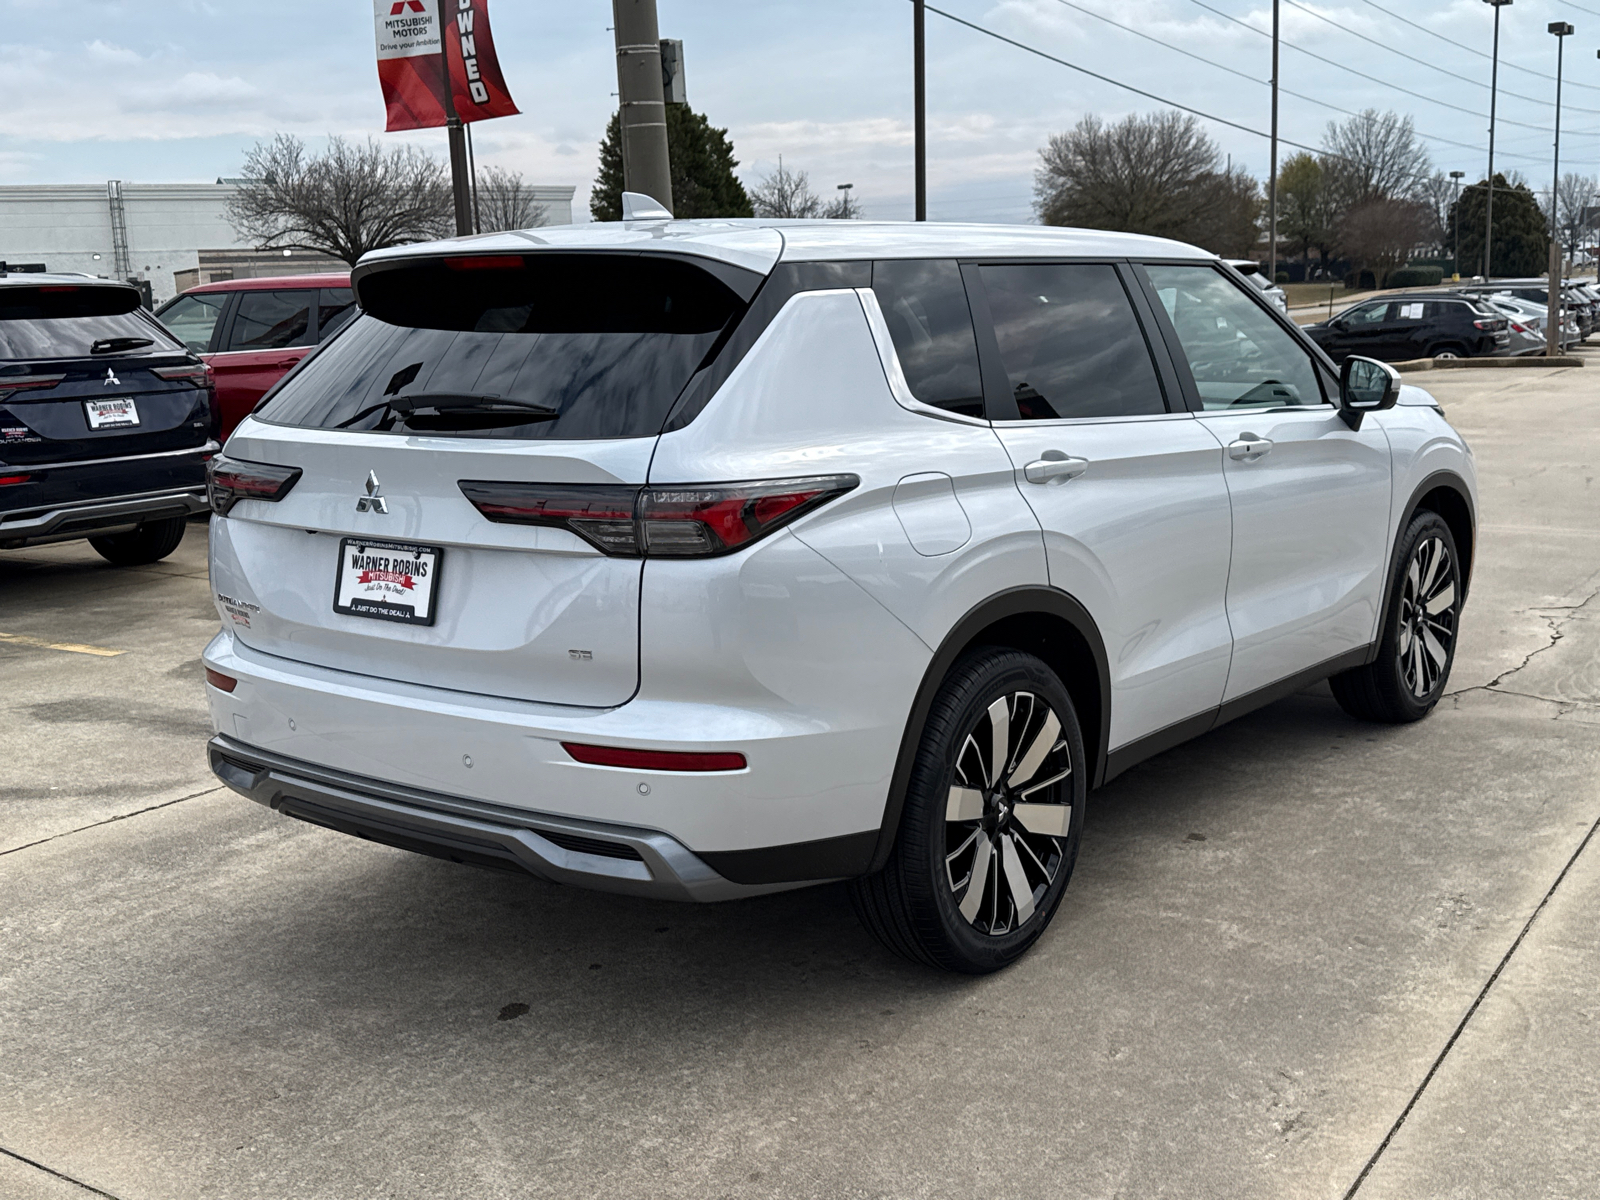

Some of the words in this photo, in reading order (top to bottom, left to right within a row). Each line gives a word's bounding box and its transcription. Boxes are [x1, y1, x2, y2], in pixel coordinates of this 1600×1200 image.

[385, 16, 433, 29] MITSUBISHI
[392, 26, 428, 39] MOTORS
[380, 43, 398, 51] Drive
[399, 42, 415, 50] your
[416, 38, 440, 47] Ambition
[352, 554, 390, 572] WARNER
[392, 558, 428, 577] ROBINS
[368, 572, 406, 584] MITSUBISHI
